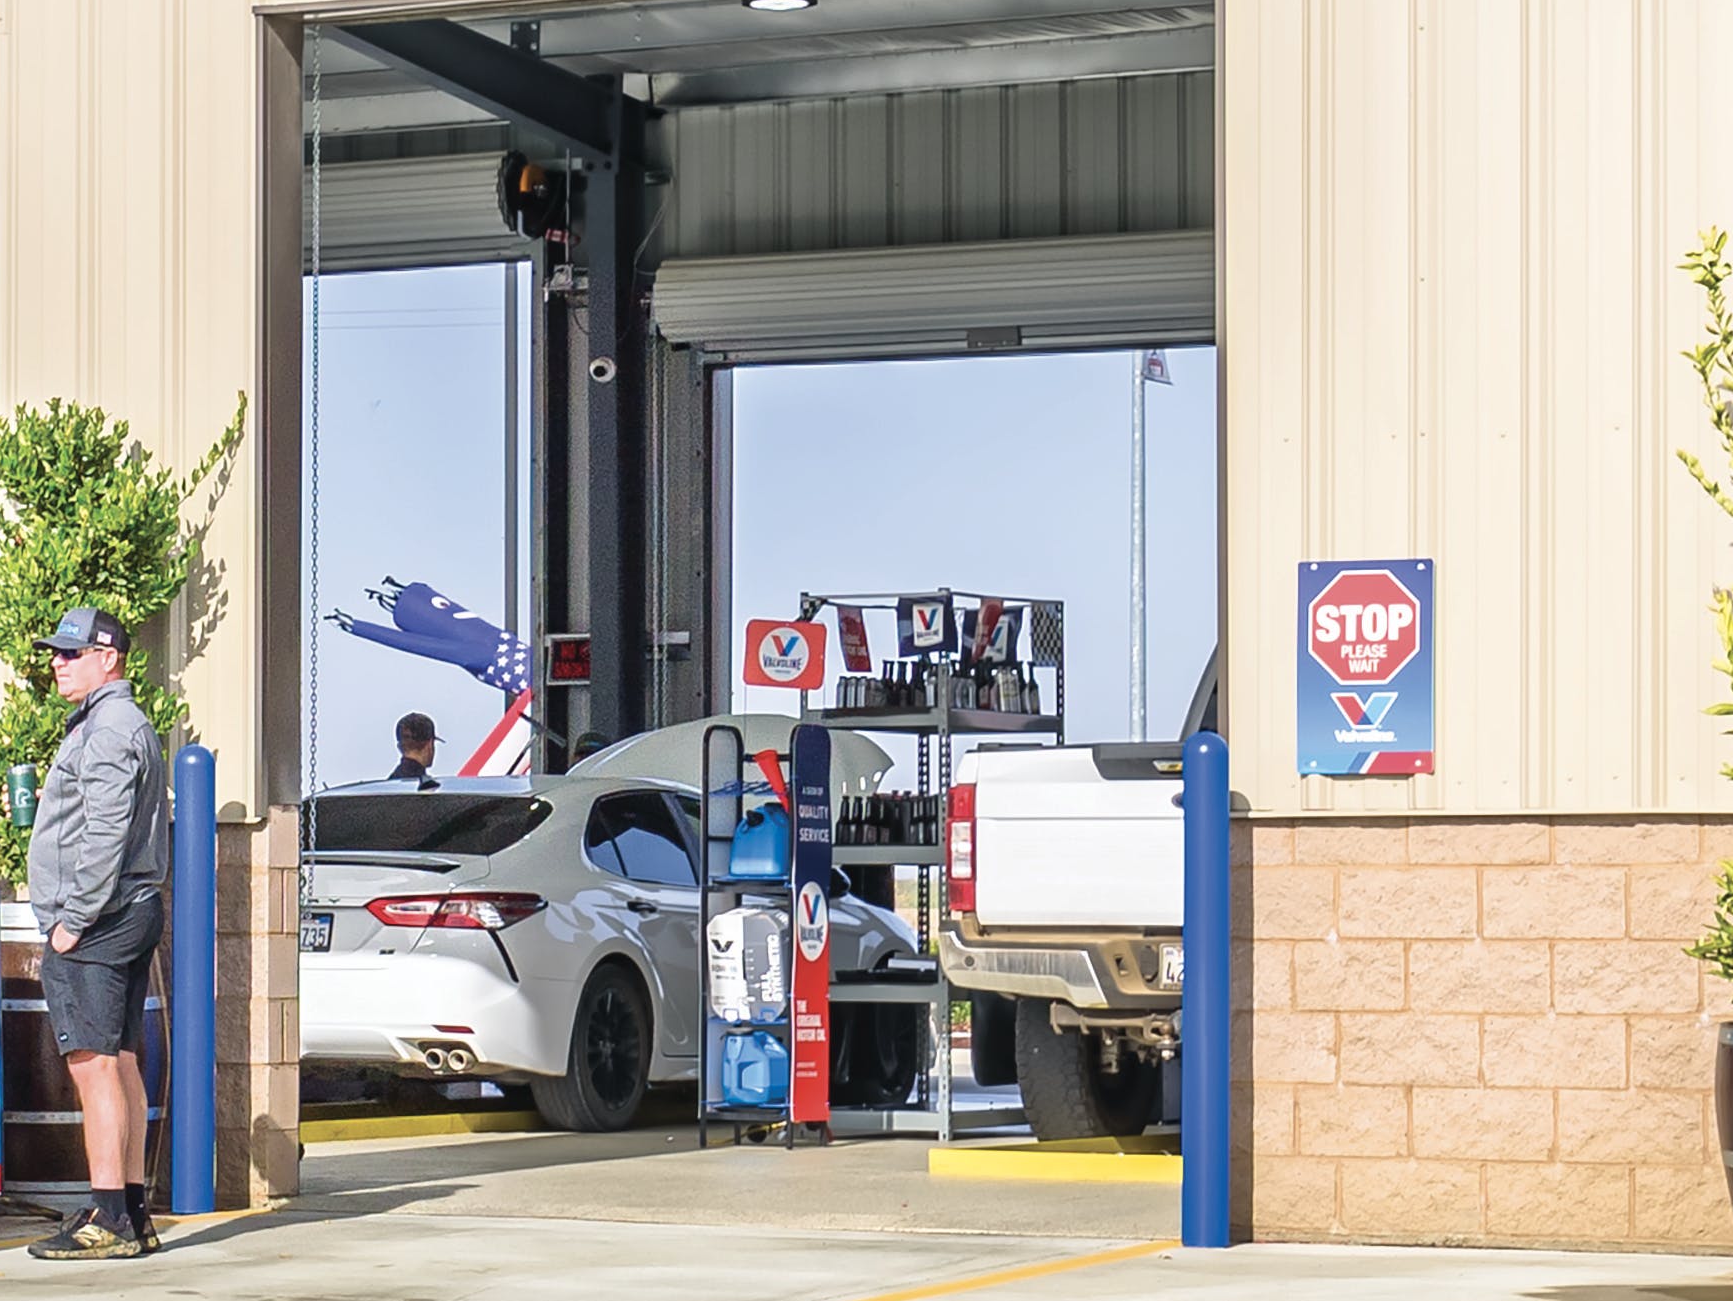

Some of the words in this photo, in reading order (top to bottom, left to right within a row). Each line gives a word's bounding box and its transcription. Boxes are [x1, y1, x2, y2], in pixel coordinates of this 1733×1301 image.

[1315, 603, 1414, 643] STOP
[1340, 644, 1388, 659] PLEASE
[1348, 658, 1381, 673] WAIT
[798, 804, 829, 819] QUALITY
[799, 827, 830, 843] SERVICE
